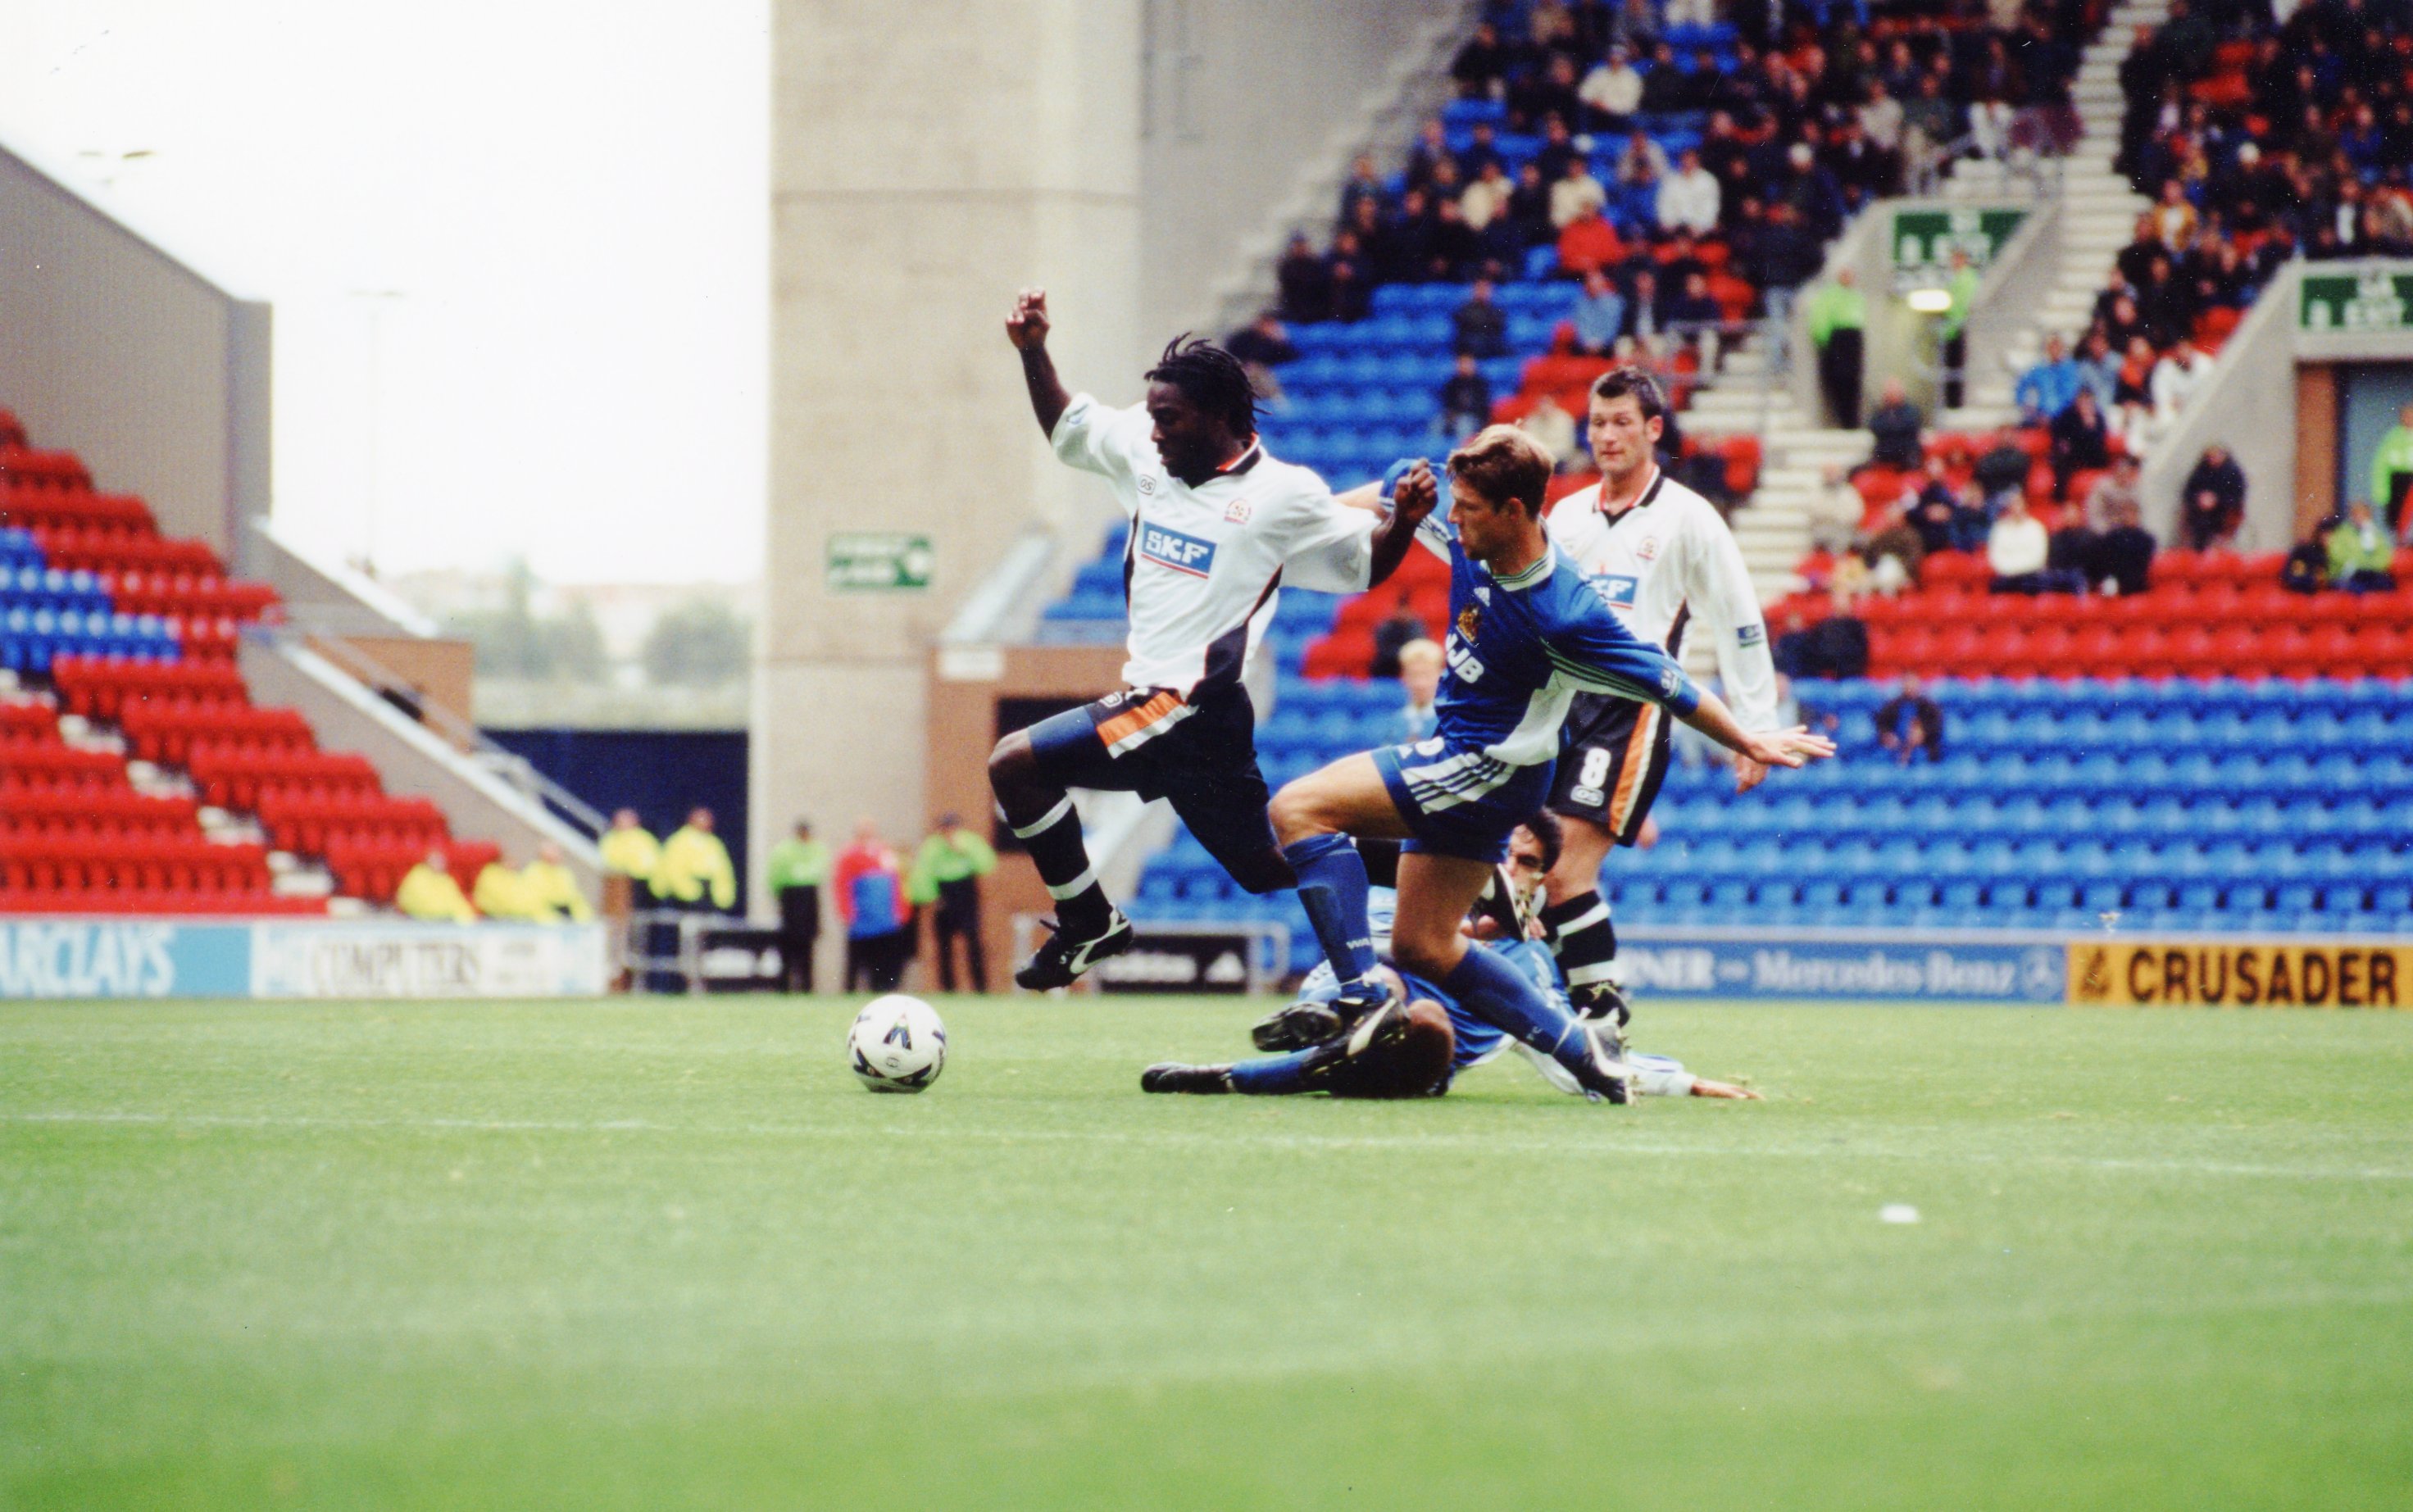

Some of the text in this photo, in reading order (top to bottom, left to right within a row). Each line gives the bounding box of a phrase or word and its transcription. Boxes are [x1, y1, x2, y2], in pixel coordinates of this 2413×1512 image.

[1146, 529, 1210, 565] SKF
[1579, 746, 1611, 788] 8
[2129, 949, 2397, 1005] CRUSADER
